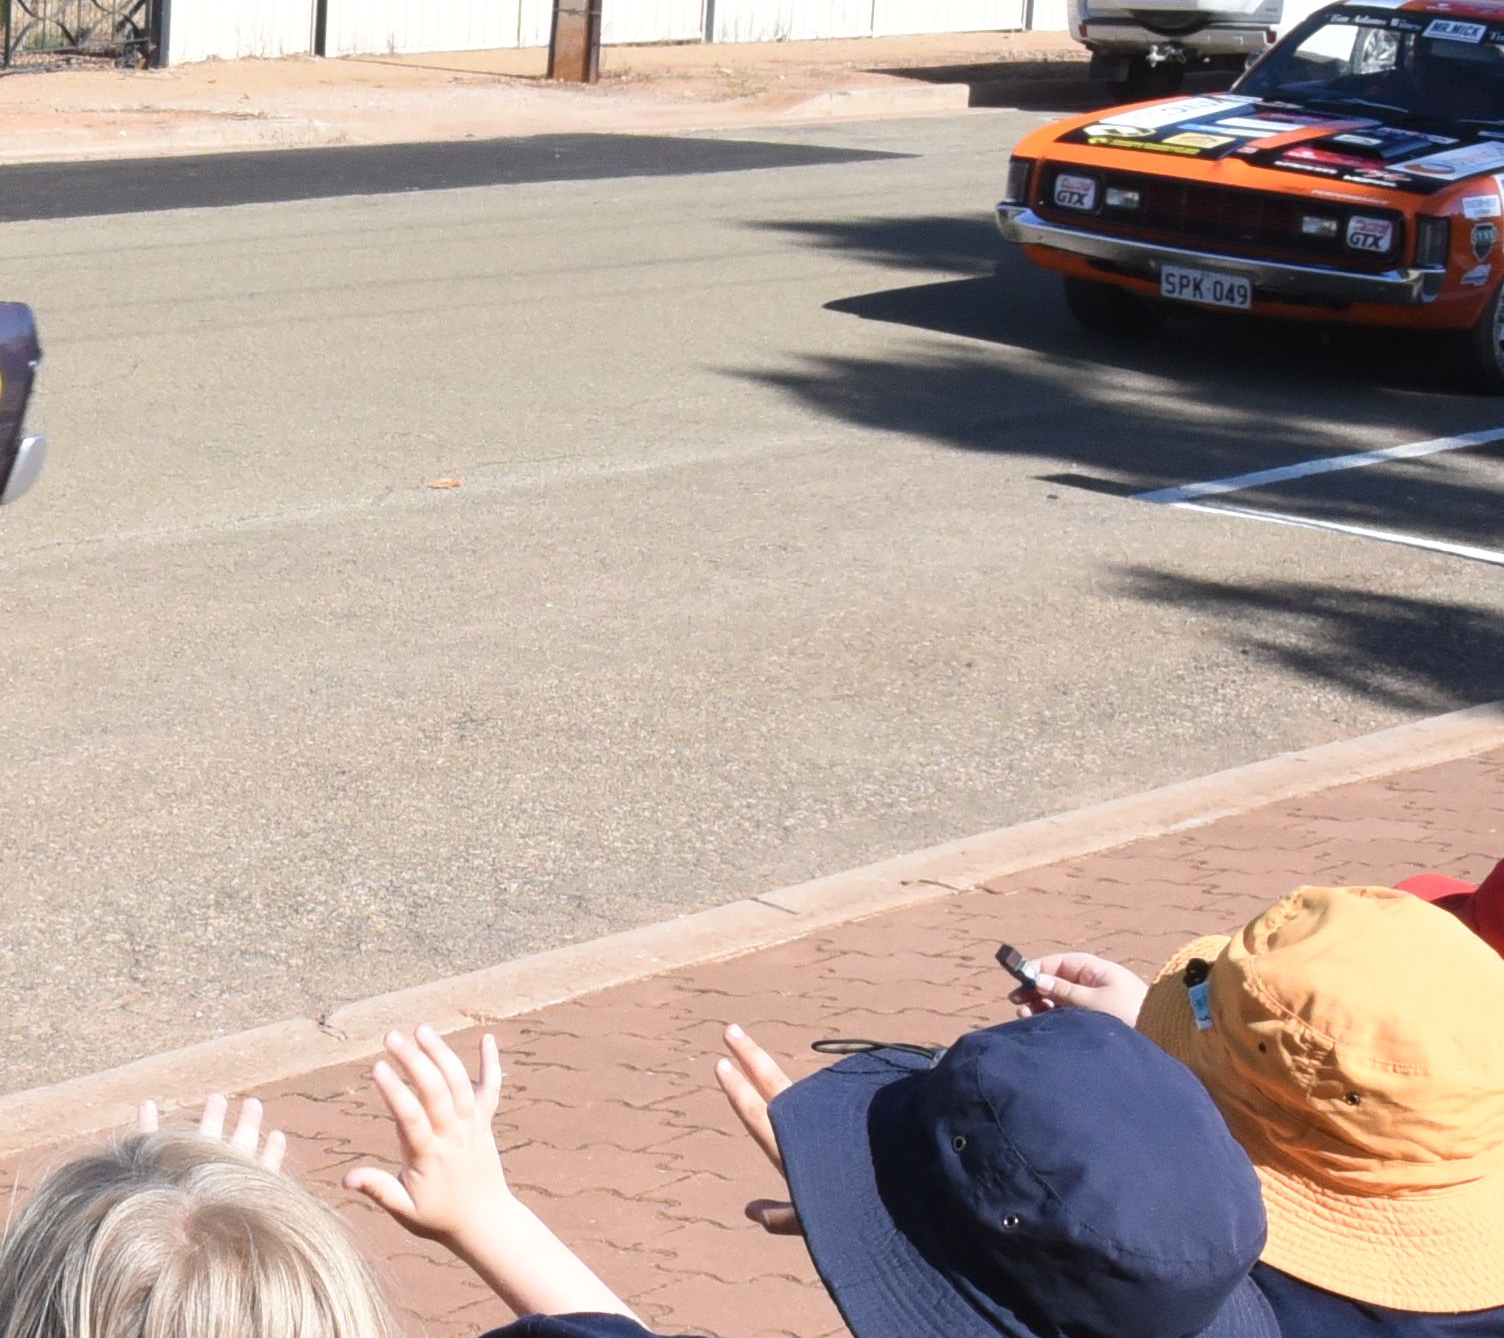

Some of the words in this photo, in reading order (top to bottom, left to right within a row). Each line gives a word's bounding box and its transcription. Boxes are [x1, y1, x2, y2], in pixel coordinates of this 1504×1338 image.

[1329, 13, 1347, 23] Tim
[1352, 14, 1387, 26] Adams
[1389, 17, 1422, 31] Wines
[1452, 24, 1481, 38] MICK
[1056, 189, 1088, 207] GTX
[1350, 232, 1385, 249] GTX
[1164, 271, 1205, 302] SPK
[1212, 280, 1249, 306] 049
